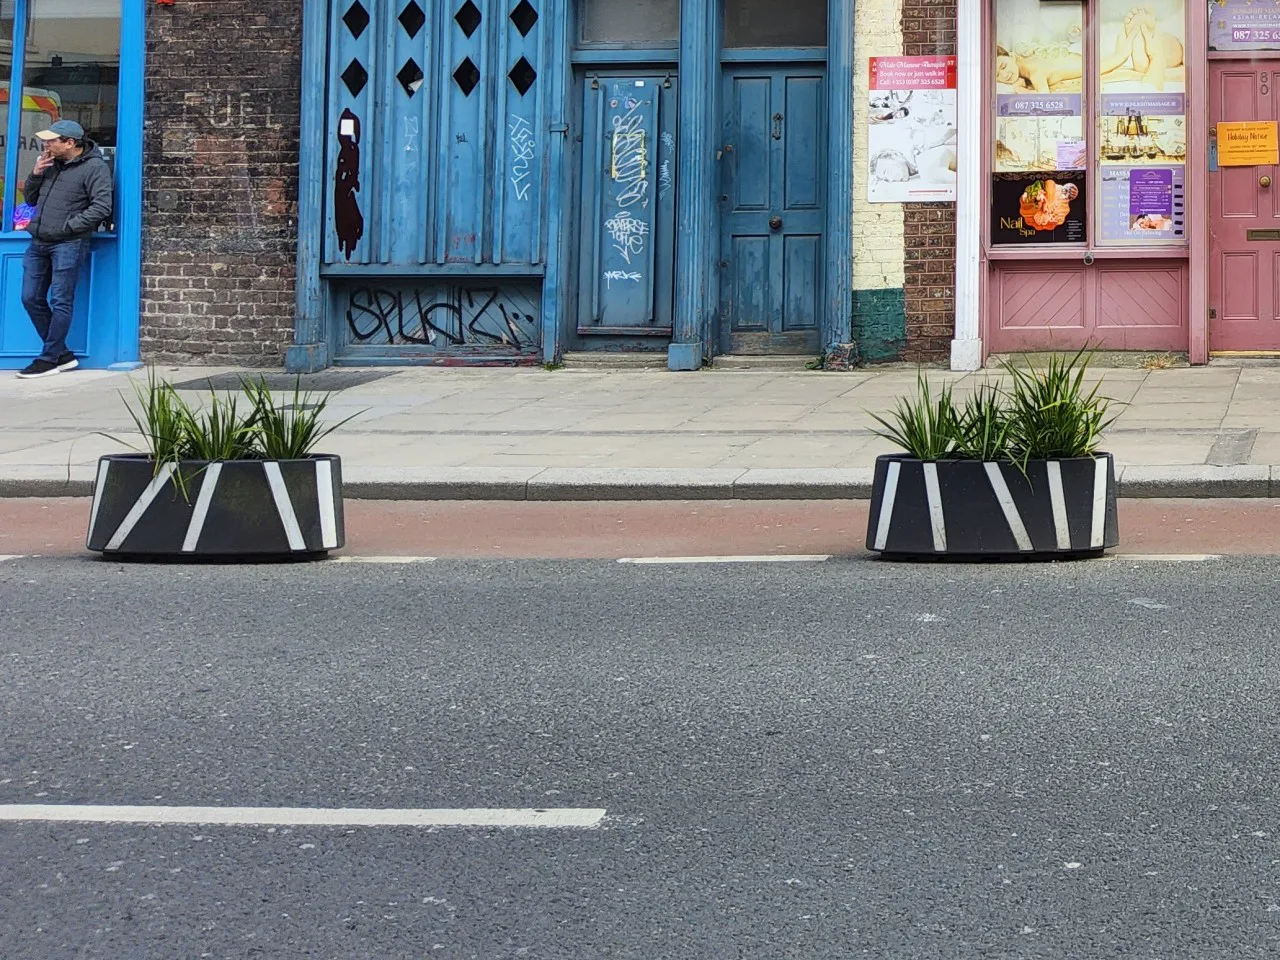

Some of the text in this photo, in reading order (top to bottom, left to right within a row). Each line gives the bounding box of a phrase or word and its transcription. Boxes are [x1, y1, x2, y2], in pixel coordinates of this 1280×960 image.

[1233, 31, 1251, 40] 087
[1253, 31, 1270, 40] 325
[914, 70, 924, 78] just
[1259, 71, 1269, 96] 80
[1015, 101, 1064, 109] 087 325 6528
[1227, 132, 1268, 143] Holiday Notice
[1000, 216, 1023, 229] Nail
[1020, 227, 1036, 238] Spa
